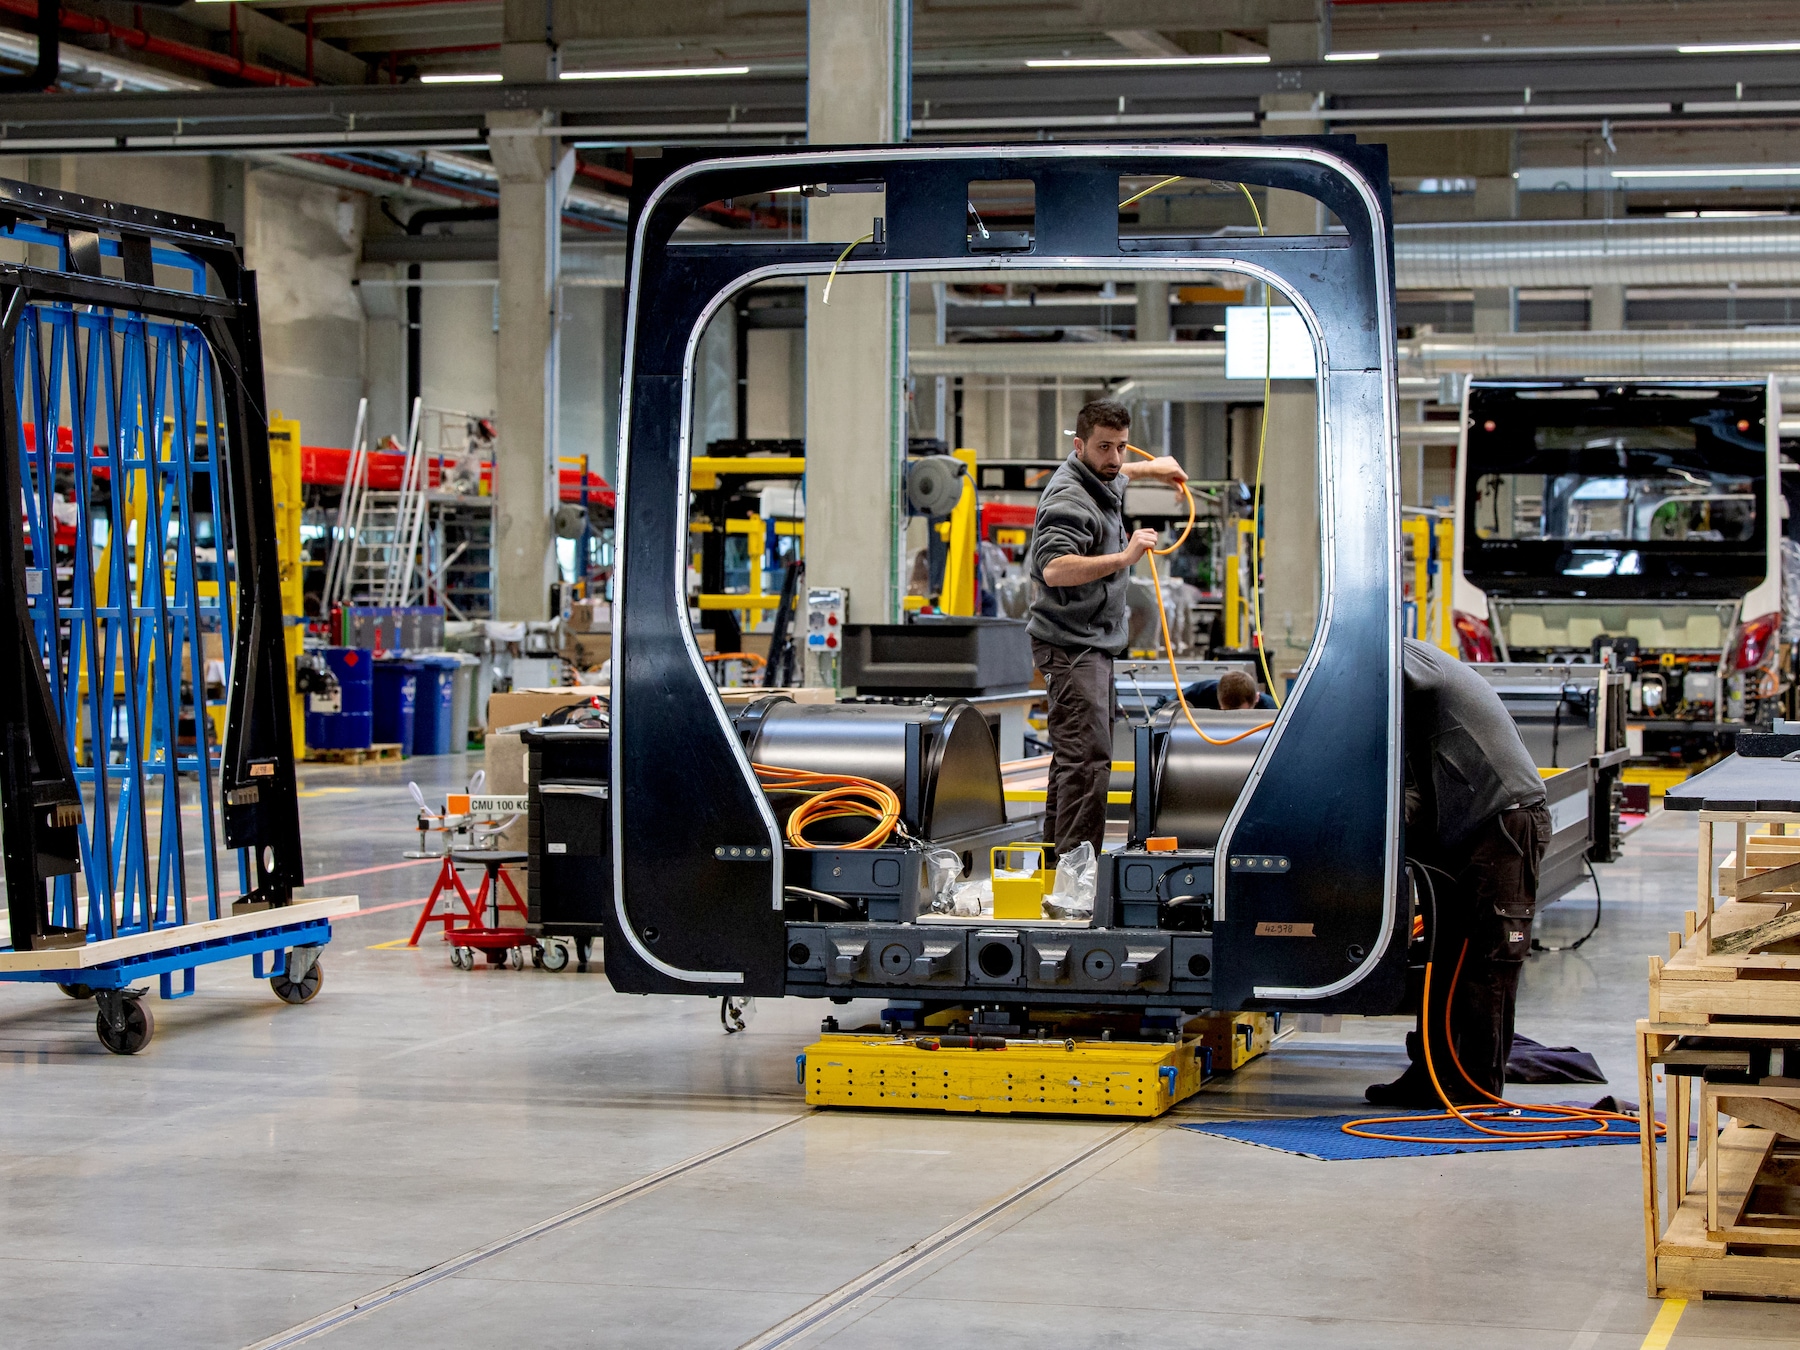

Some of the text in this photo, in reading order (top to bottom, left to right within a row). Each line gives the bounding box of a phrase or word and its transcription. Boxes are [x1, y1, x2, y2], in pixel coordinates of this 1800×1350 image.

[471, 800, 529, 811] CMU 100 KG
